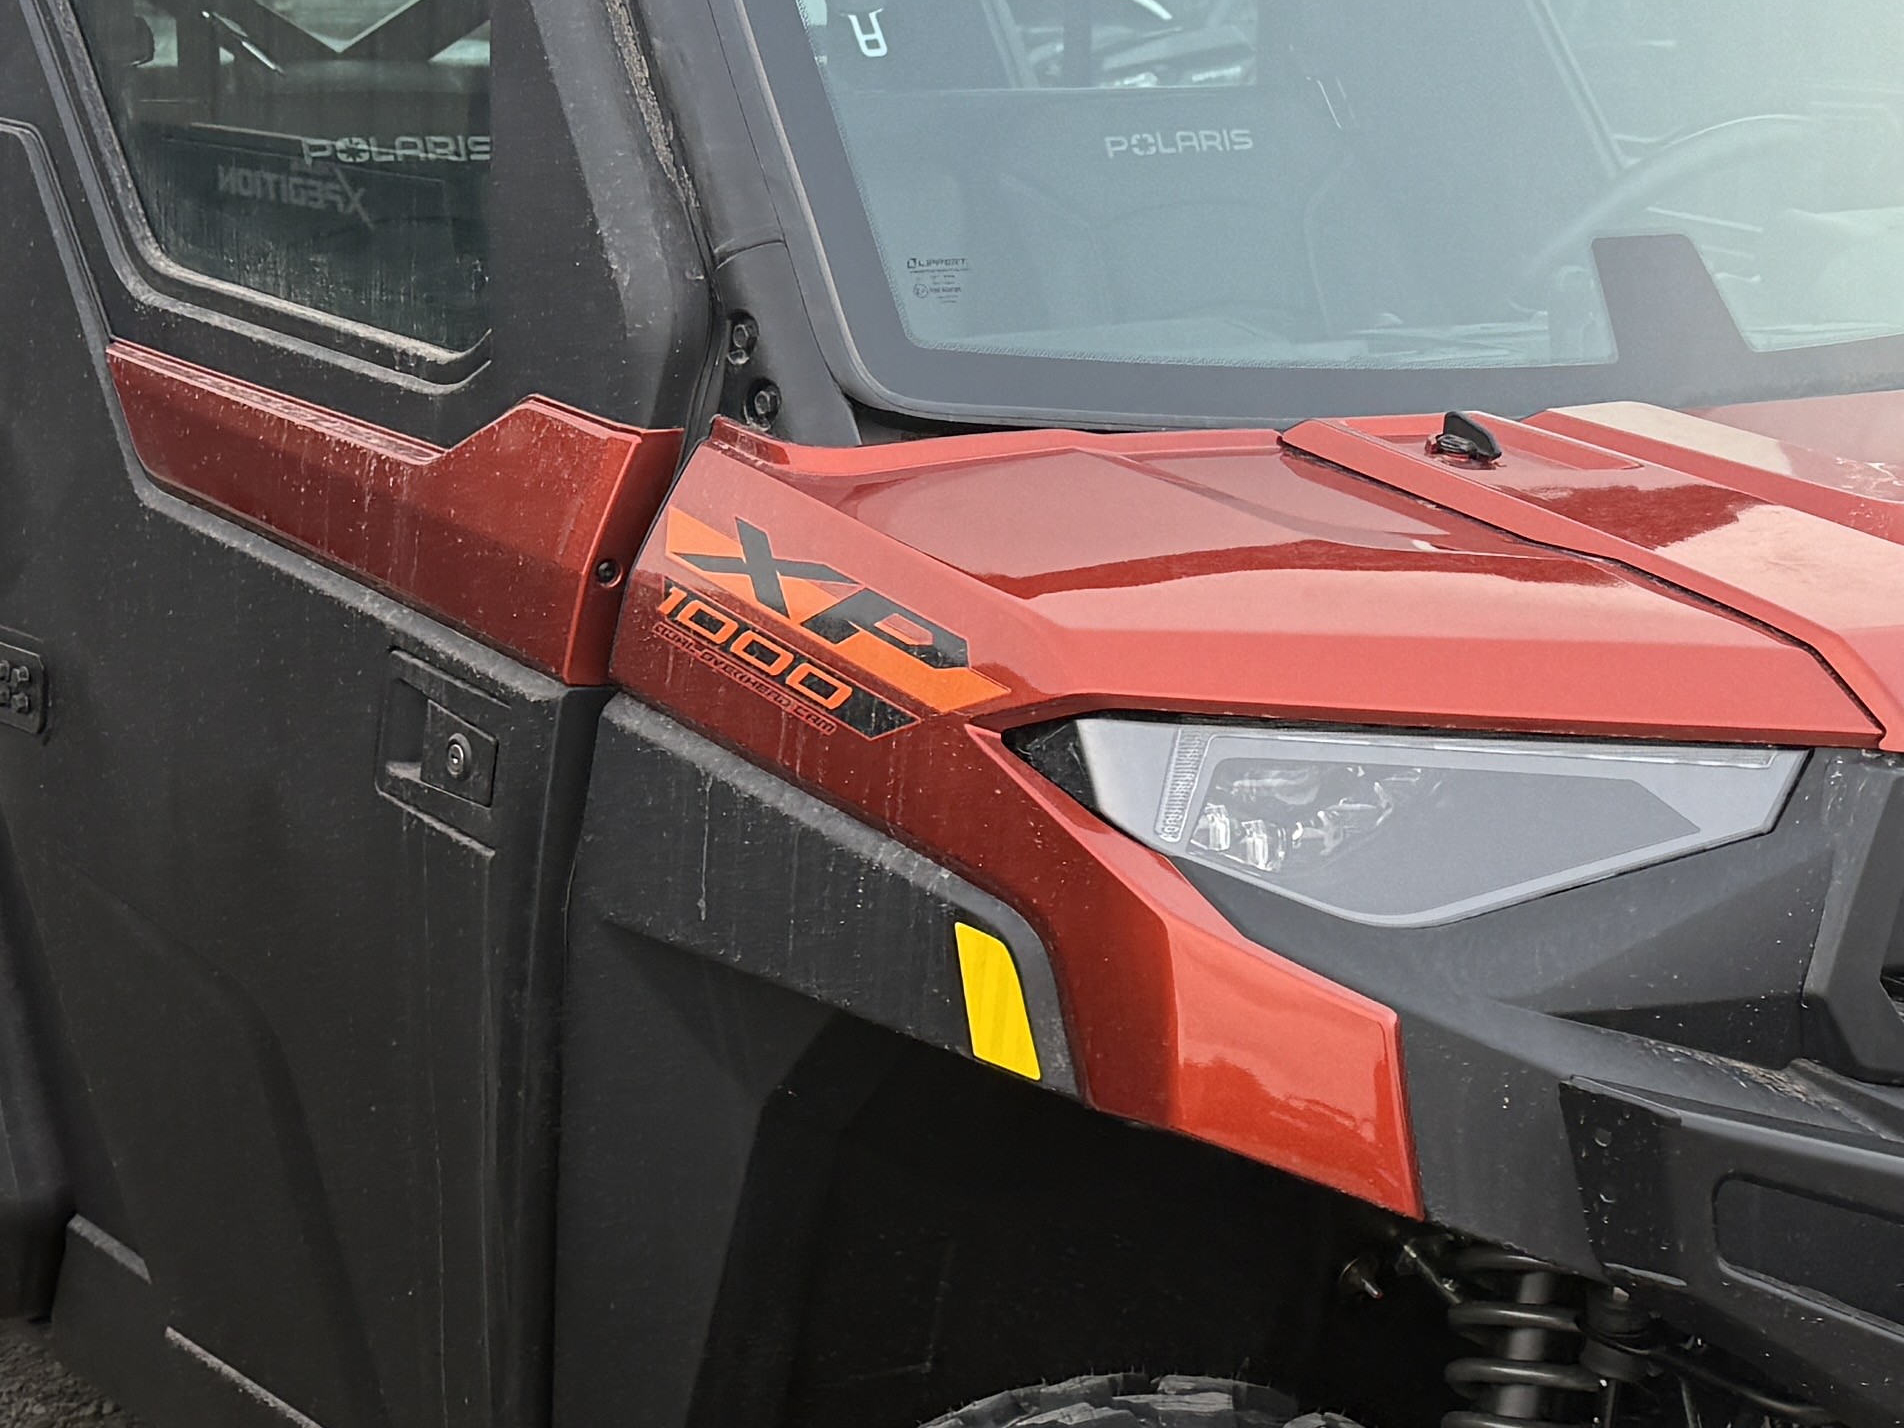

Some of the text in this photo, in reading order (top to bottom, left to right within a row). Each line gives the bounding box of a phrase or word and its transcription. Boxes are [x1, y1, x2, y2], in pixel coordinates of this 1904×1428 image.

[301, 135, 492, 167] POLARIS
[1104, 128, 1254, 160] POLARIS
[671, 516, 970, 669] XP
[658, 585, 855, 711] 1000
[793, 704, 836, 734] CAM
